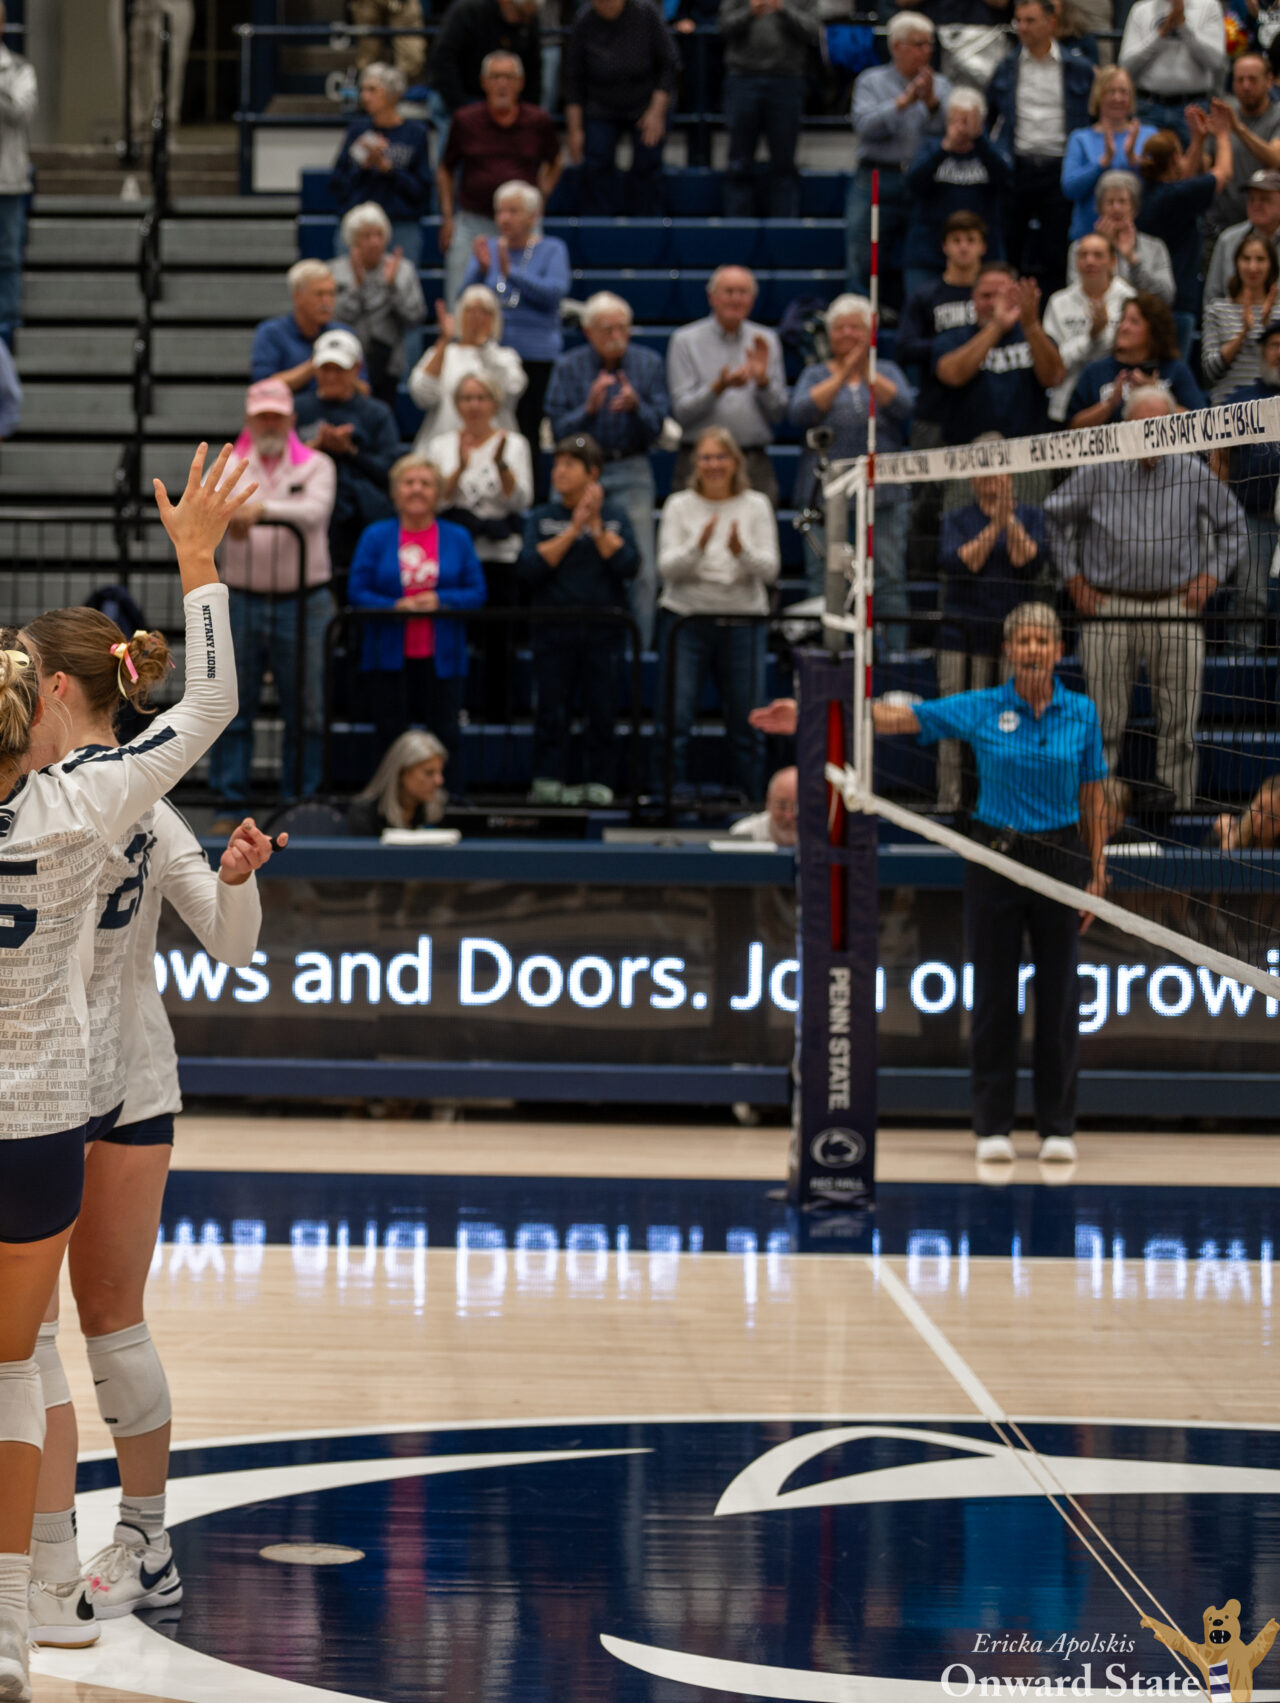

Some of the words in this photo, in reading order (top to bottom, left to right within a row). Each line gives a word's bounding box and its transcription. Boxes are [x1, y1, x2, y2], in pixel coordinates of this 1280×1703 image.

[202, 604, 215, 648] NITTANY
[207, 650, 216, 678] LIONS
[0, 979, 18, 987] WE
[20, 978, 41, 987] ARE
[292, 936, 432, 1005] and
[458, 937, 709, 1010] Doors.
[829, 967, 851, 1034] PENN
[10, 1031, 33, 1039] ARE
[829, 1036, 851, 1111] STATE
[9, 1091, 31, 1100] ARE
[6, 1123, 29, 1132] ARE
